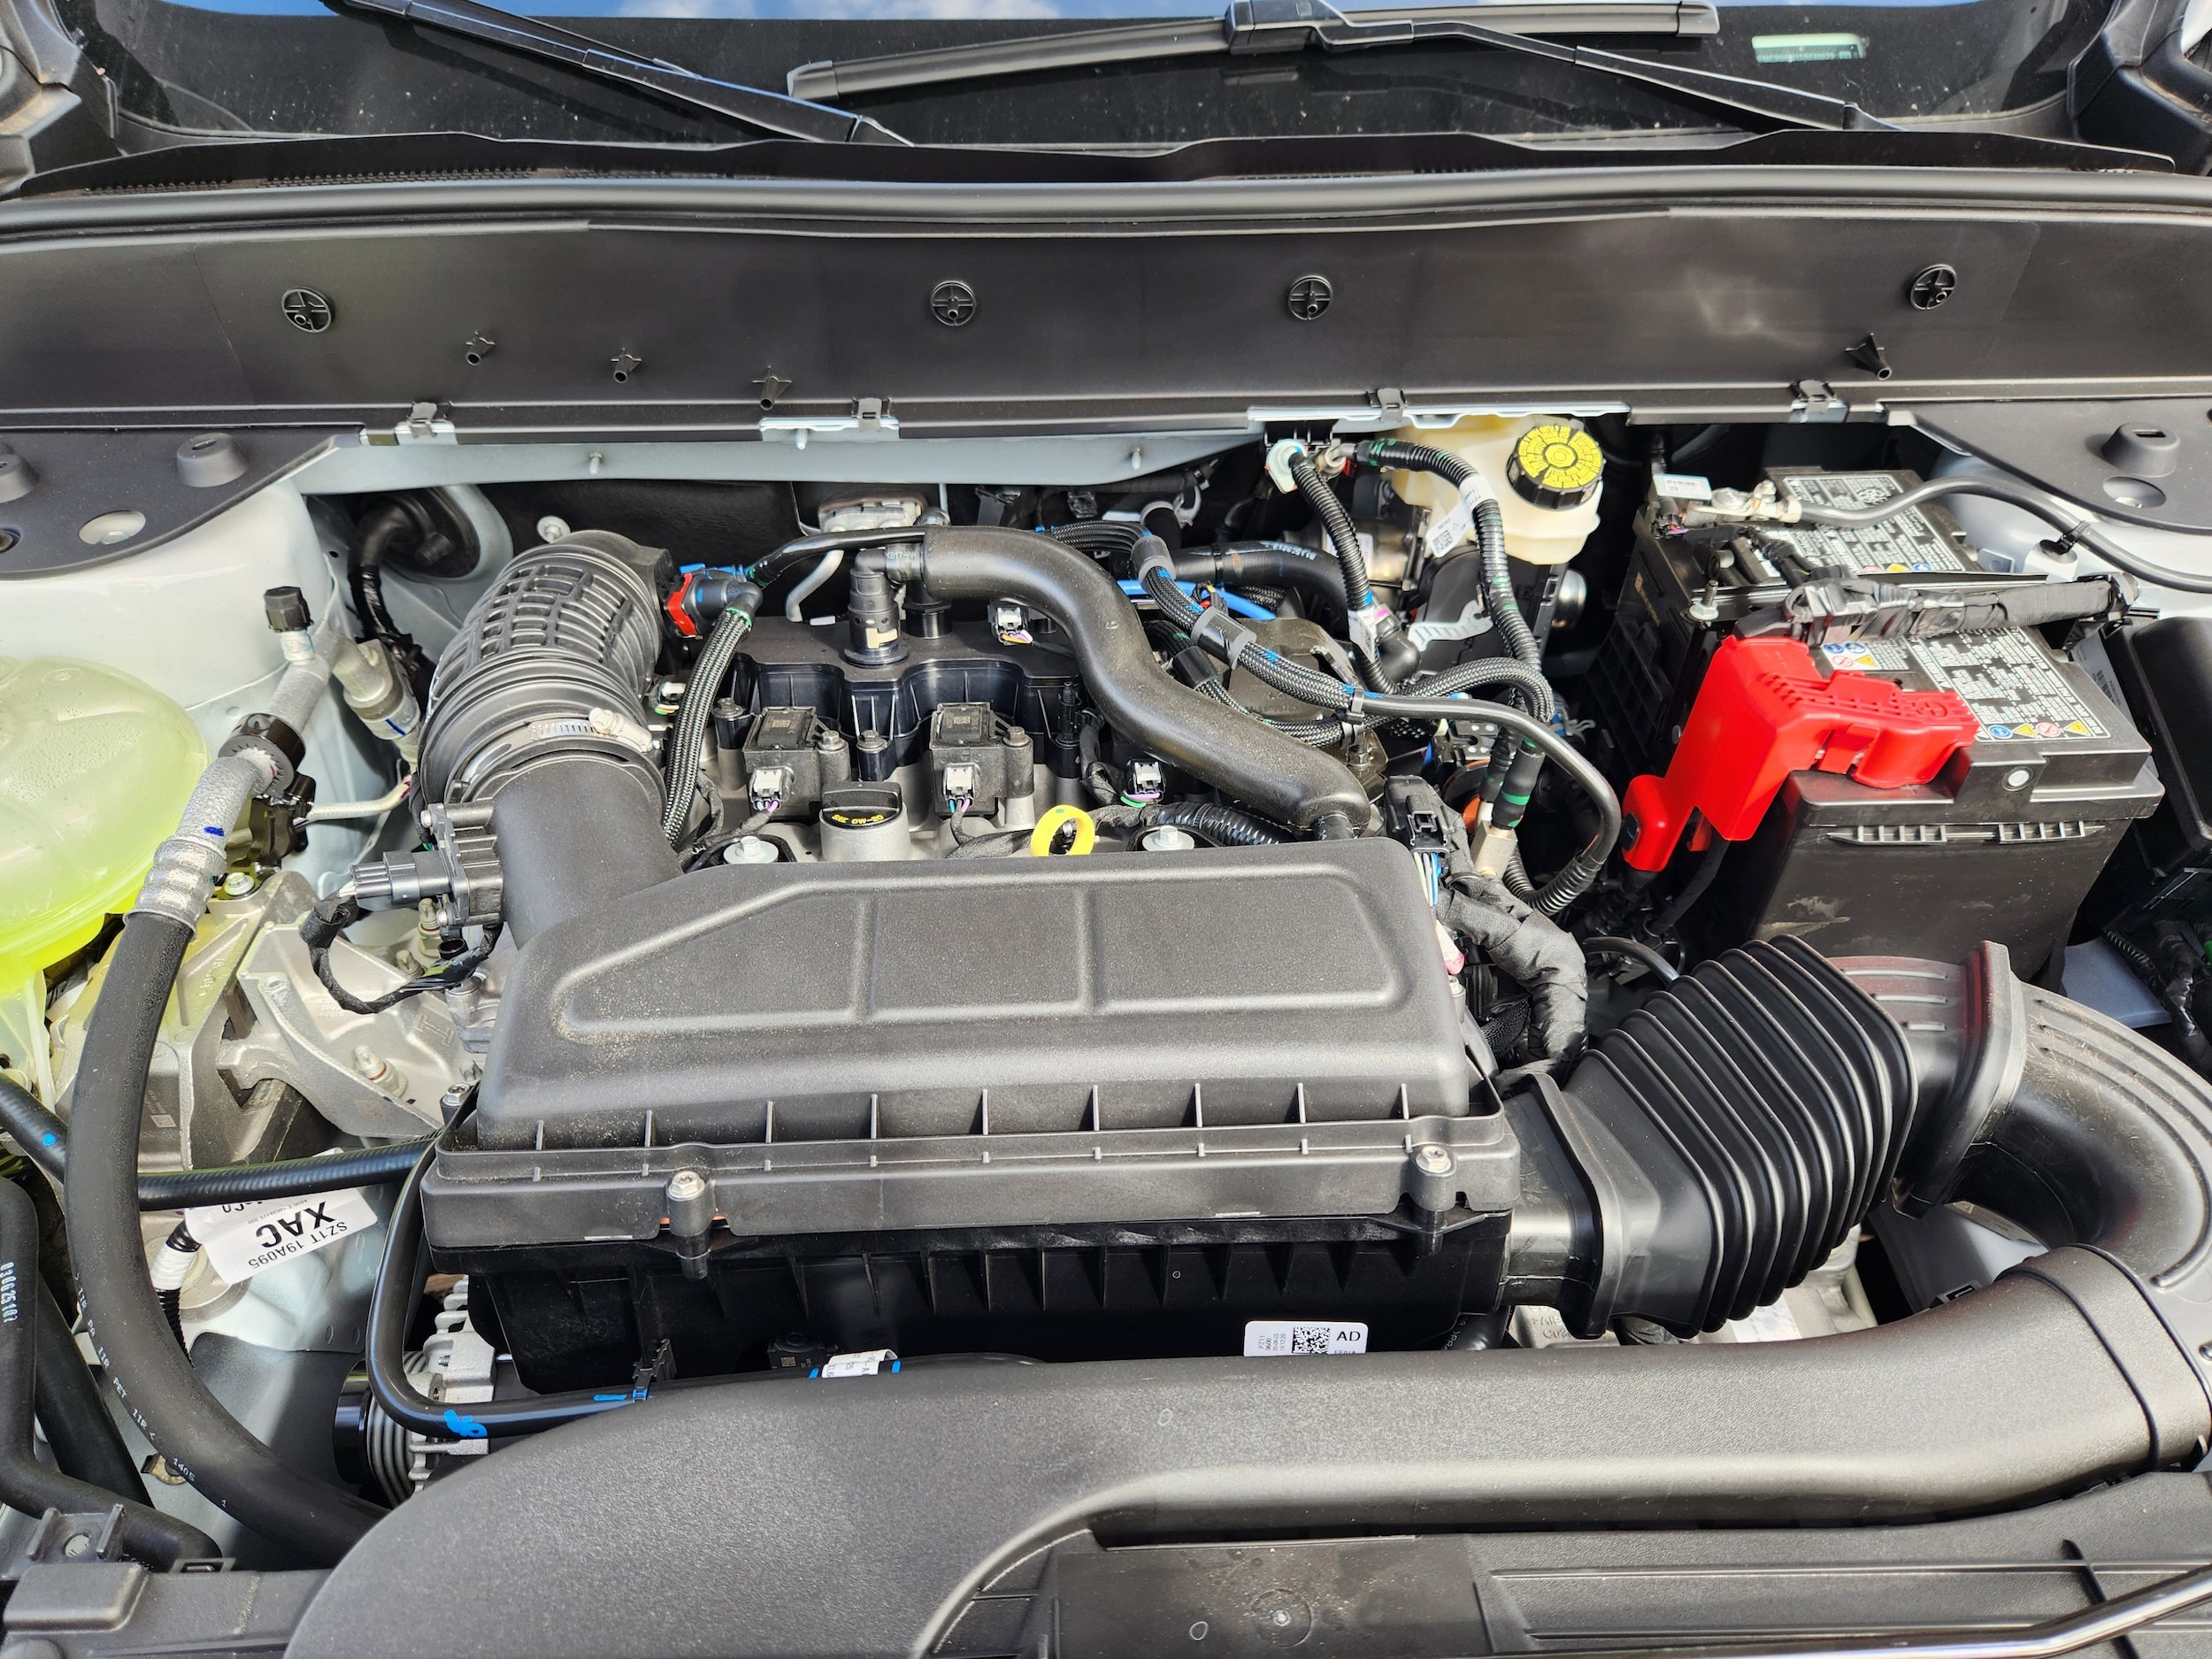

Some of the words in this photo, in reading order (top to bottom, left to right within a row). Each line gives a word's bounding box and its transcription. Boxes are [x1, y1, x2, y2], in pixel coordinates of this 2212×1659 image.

[832, 814, 849, 824] SAE
[255, 1201, 338, 1248] XAC
[311, 1221, 349, 1244] SZ1T
[248, 1240, 305, 1269] 19A095
[1336, 1331, 1361, 1342] AD
[112, 1377, 128, 1399] PET
[172, 1457, 196, 1482] 1405
